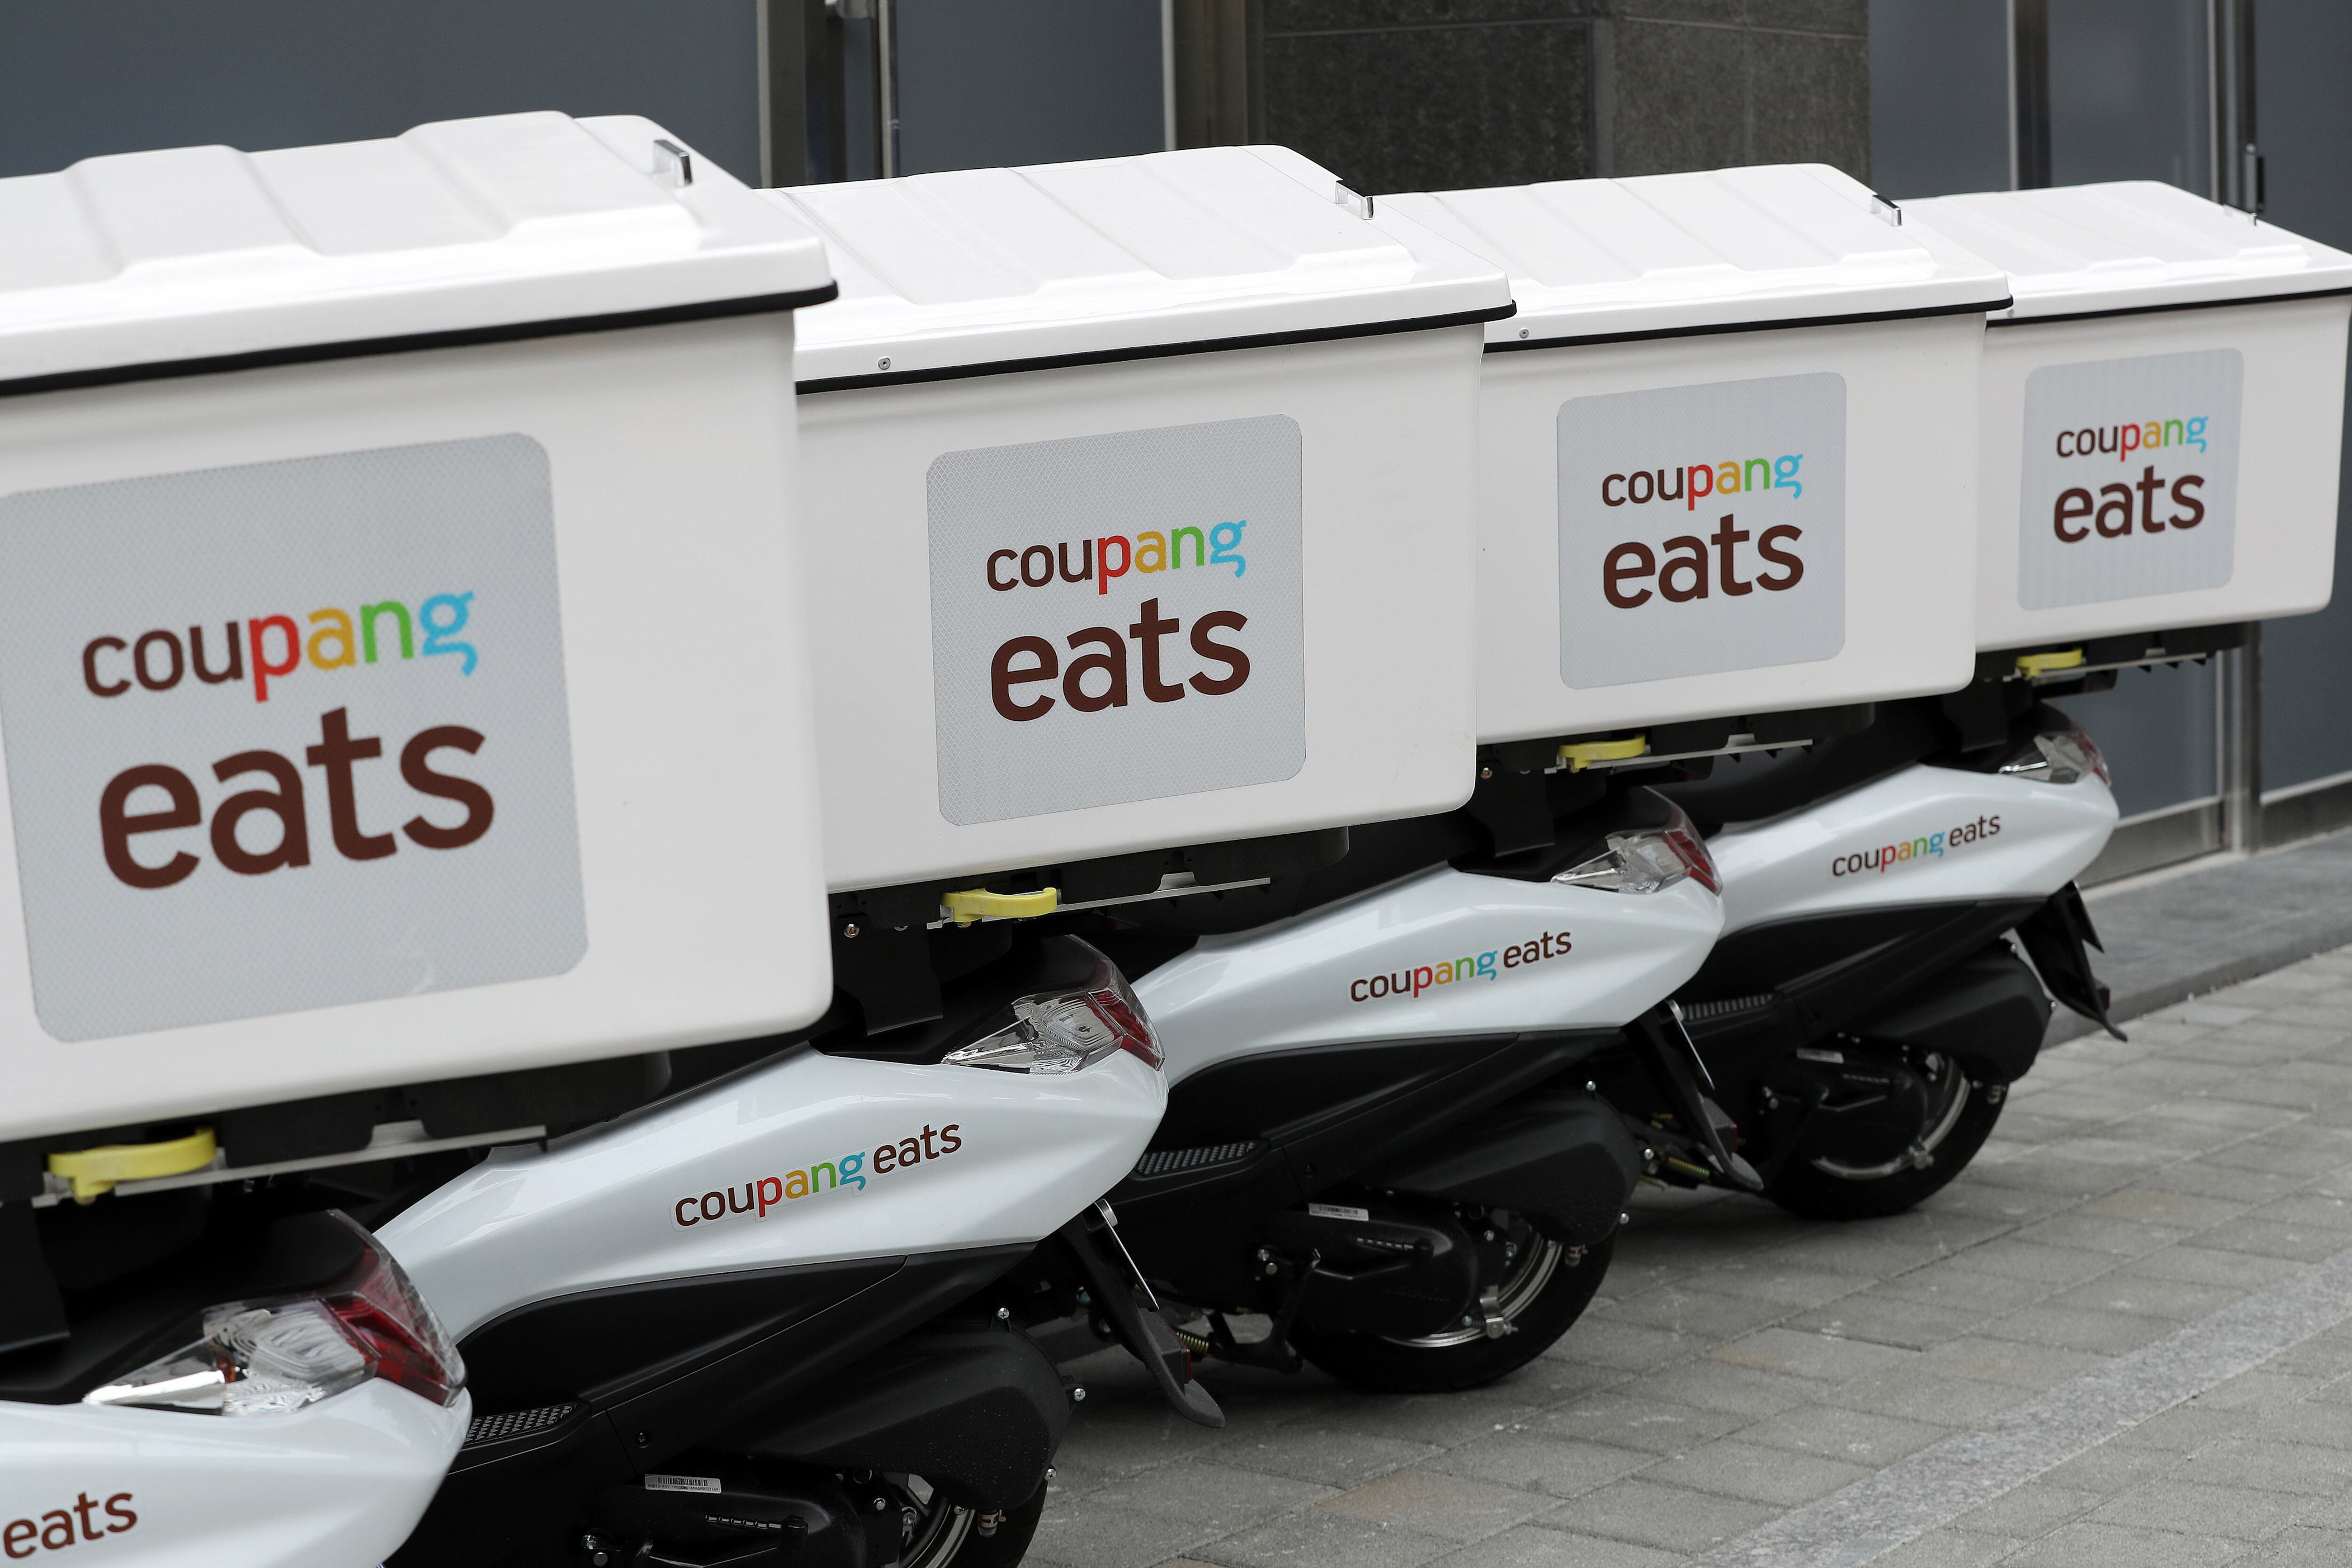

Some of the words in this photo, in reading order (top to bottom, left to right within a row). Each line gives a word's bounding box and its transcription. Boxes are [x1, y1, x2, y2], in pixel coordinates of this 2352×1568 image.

[2056, 417, 2208, 462] coupang
[1603, 454, 1803, 511] coupang
[2054, 465, 2205, 544] eats
[987, 520, 1246, 595] coupang
[1604, 514, 1803, 608] eats
[83, 591, 478, 702] coupang
[991, 598, 1250, 721] eats
[100, 707, 493, 888] eats
[1832, 832, 1945, 876] coupang
[1949, 815, 2000, 847] eats
[1351, 951, 1498, 1002] coupang
[1504, 932, 1572, 968] eats
[676, 1152, 866, 1226] coupang
[873, 1124, 962, 1174] eats
[3, 1492, 138, 1558] eats
